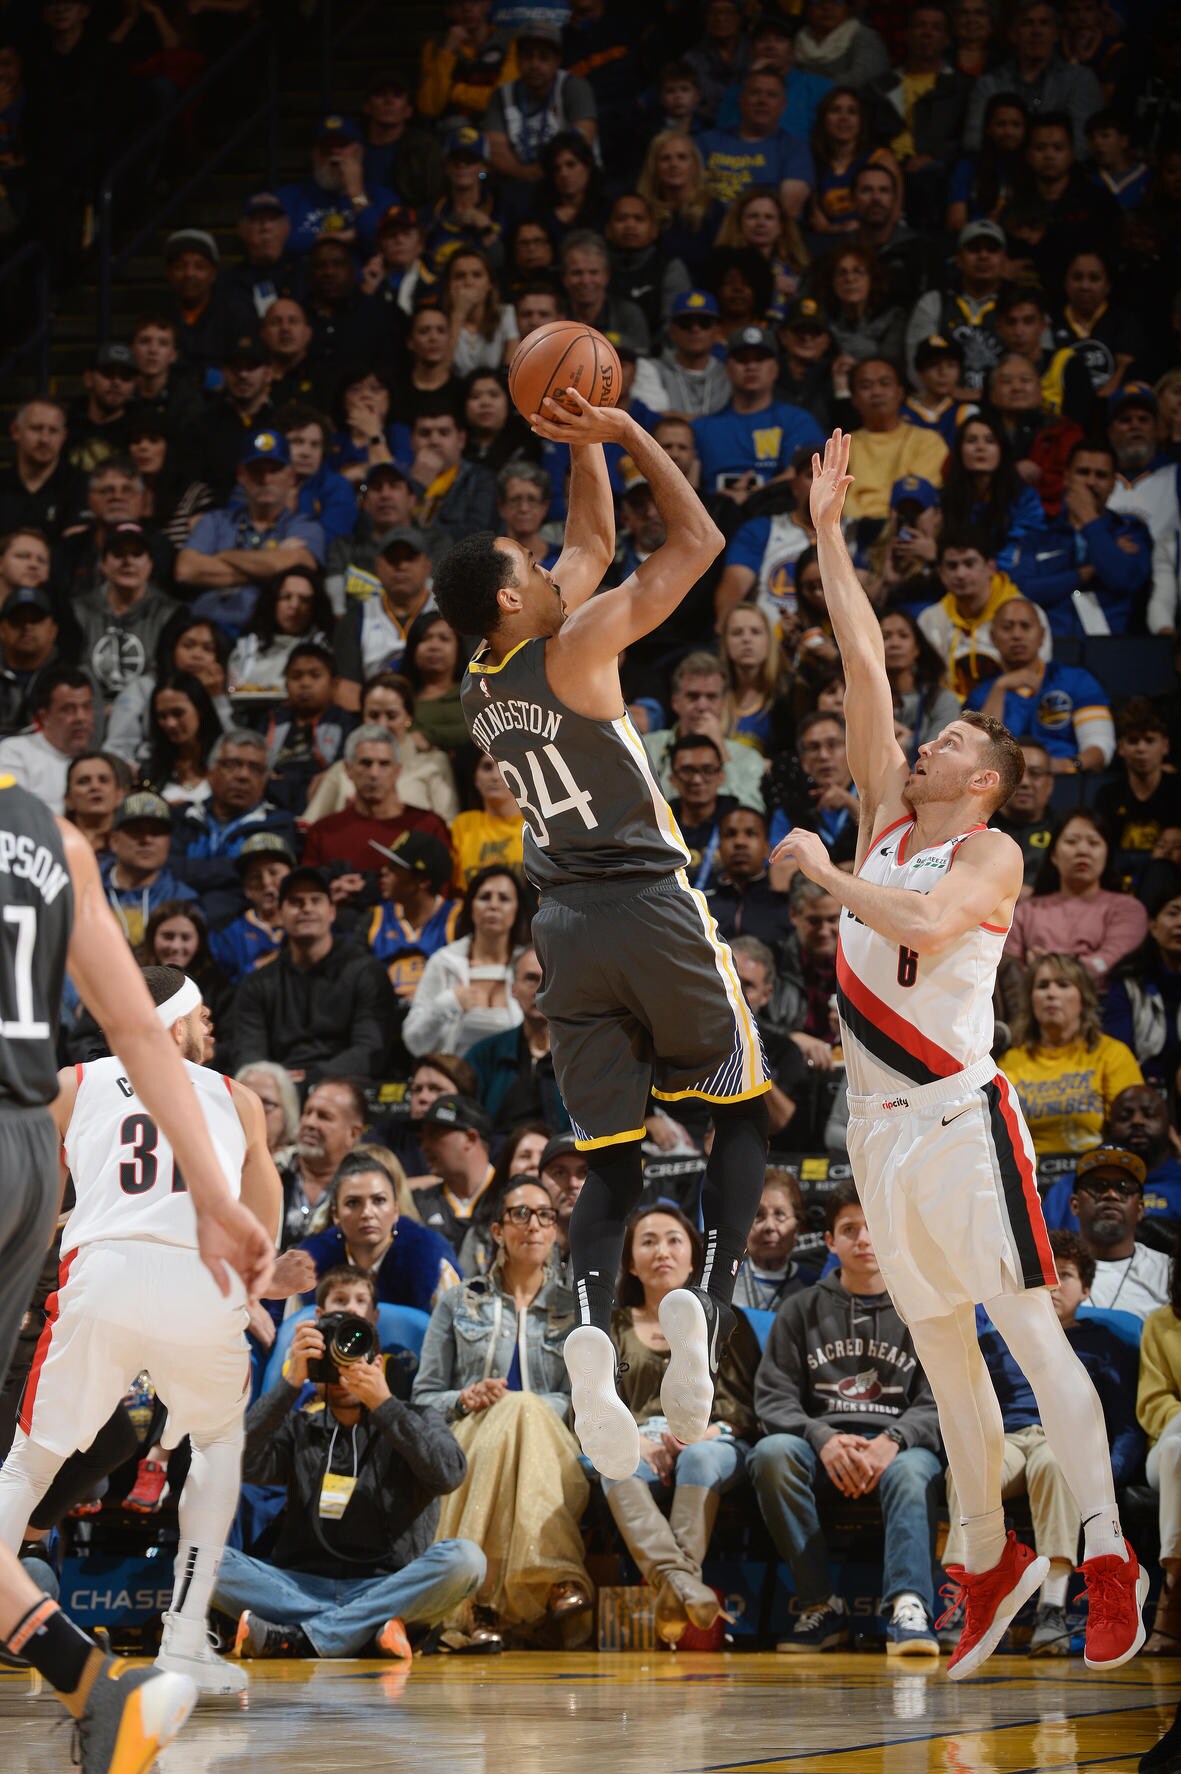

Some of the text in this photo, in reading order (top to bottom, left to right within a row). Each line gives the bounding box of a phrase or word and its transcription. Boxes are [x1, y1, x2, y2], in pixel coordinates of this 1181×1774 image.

[473, 700, 563, 752] IVINGSTON
[498, 743, 598, 848] 34
[807, 1338, 917, 1372] SACRED HEART
[71, 1590, 174, 1610] CHASE
